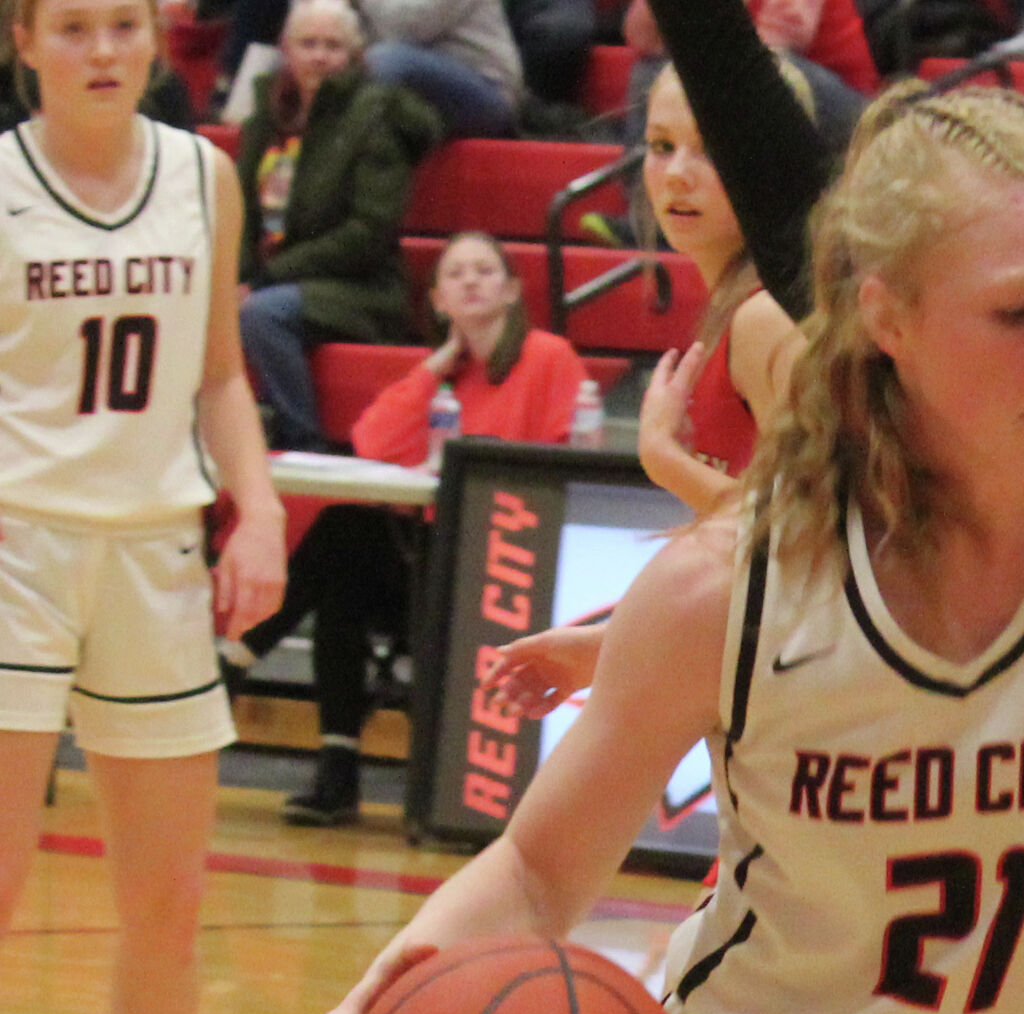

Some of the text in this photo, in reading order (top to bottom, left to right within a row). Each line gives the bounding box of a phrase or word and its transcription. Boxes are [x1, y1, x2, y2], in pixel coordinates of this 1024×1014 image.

[26, 255, 196, 301] REED CITY
[76, 312, 159, 416] 10
[480, 491, 541, 631] CITY
[789, 745, 956, 824] REED
